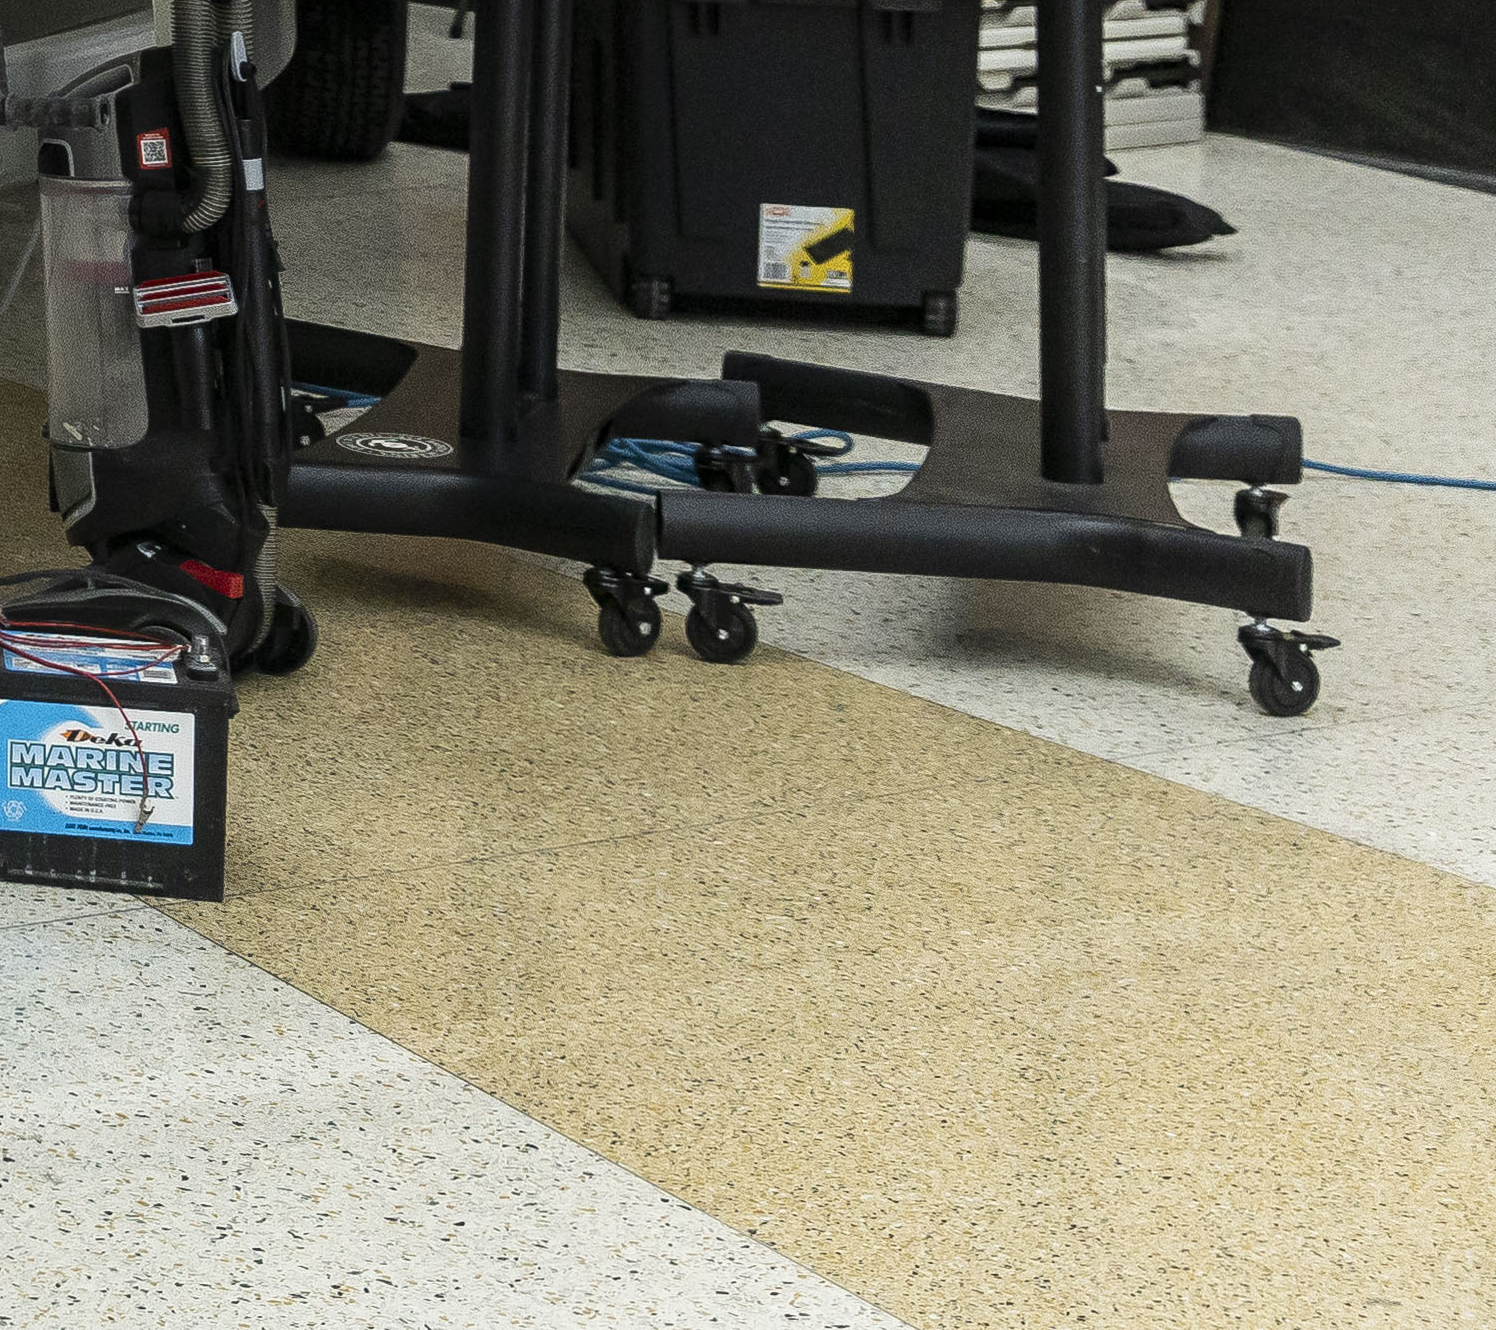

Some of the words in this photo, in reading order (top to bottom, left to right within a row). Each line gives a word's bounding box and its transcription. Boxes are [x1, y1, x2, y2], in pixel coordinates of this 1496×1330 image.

[60, 729, 143, 748] Deka
[124, 720, 180, 734] STARTING
[9, 741, 174, 777] MARINE
[9, 765, 175, 800] MASTER
